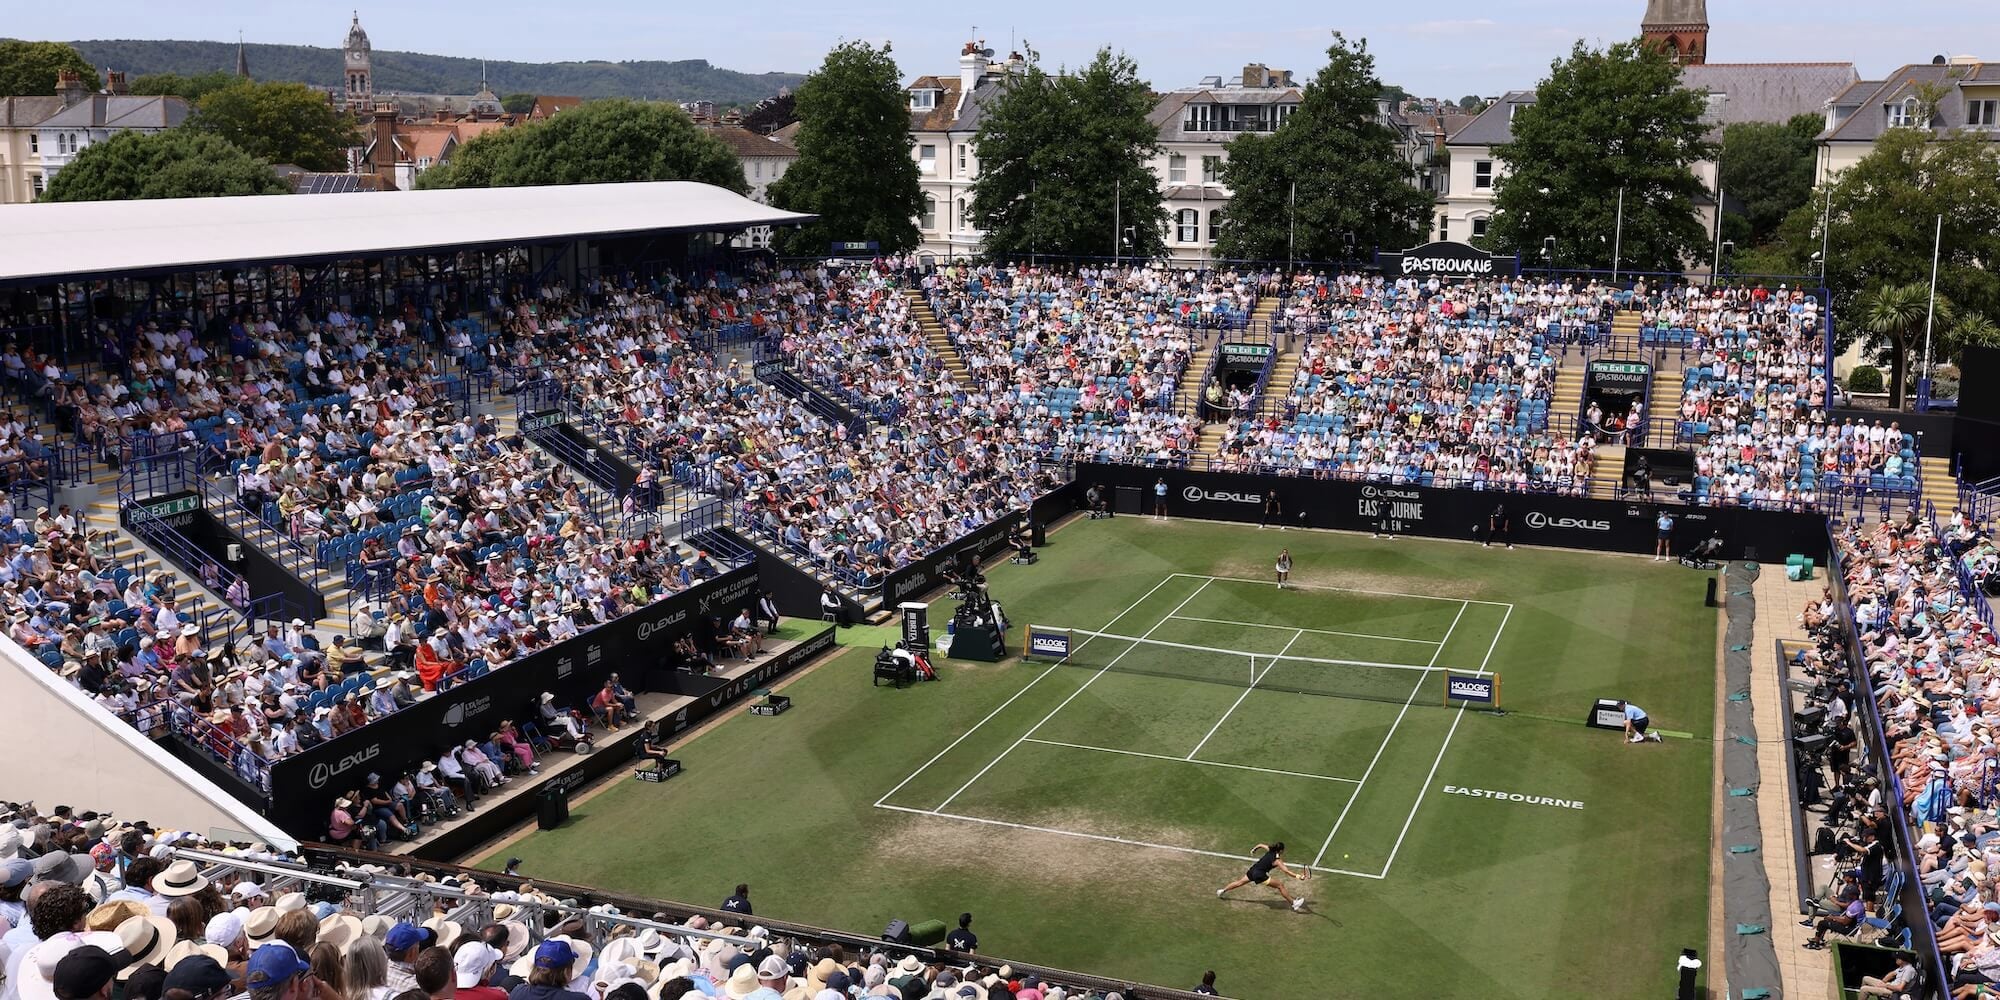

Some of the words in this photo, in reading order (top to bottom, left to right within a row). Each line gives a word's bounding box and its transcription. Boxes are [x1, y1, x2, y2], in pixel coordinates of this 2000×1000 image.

[1401, 256, 1492, 274] EASTBOURNE
[1226, 355, 1267, 364] EASTBOURN
[1593, 364, 1608, 372] Fire
[1609, 365, 1625, 373] Exit
[1595, 373, 1643, 382] EASTBOURNE
[1204, 490, 1261, 503] LEXUS
[1377, 489, 1419, 499] LEXUS
[152, 502, 171, 517] Exit
[1358, 499, 1423, 520] EASOURNE
[1381, 519, 1401, 531] OEN
[1547, 516, 1610, 531] LEXUS
[711, 587, 729, 600] CREW
[729, 573, 759, 592] CLOTHING
[721, 587, 750, 605] COMPANY
[651, 609, 686, 629] LEXUS
[1033, 637, 1067, 648] HOLOGIC
[726, 661, 779, 698] CASORE
[1451, 681, 1489, 692] HOLOGIC
[330, 743, 380, 776] LEXUS
[1443, 785, 1585, 810] EASTBOURNE
